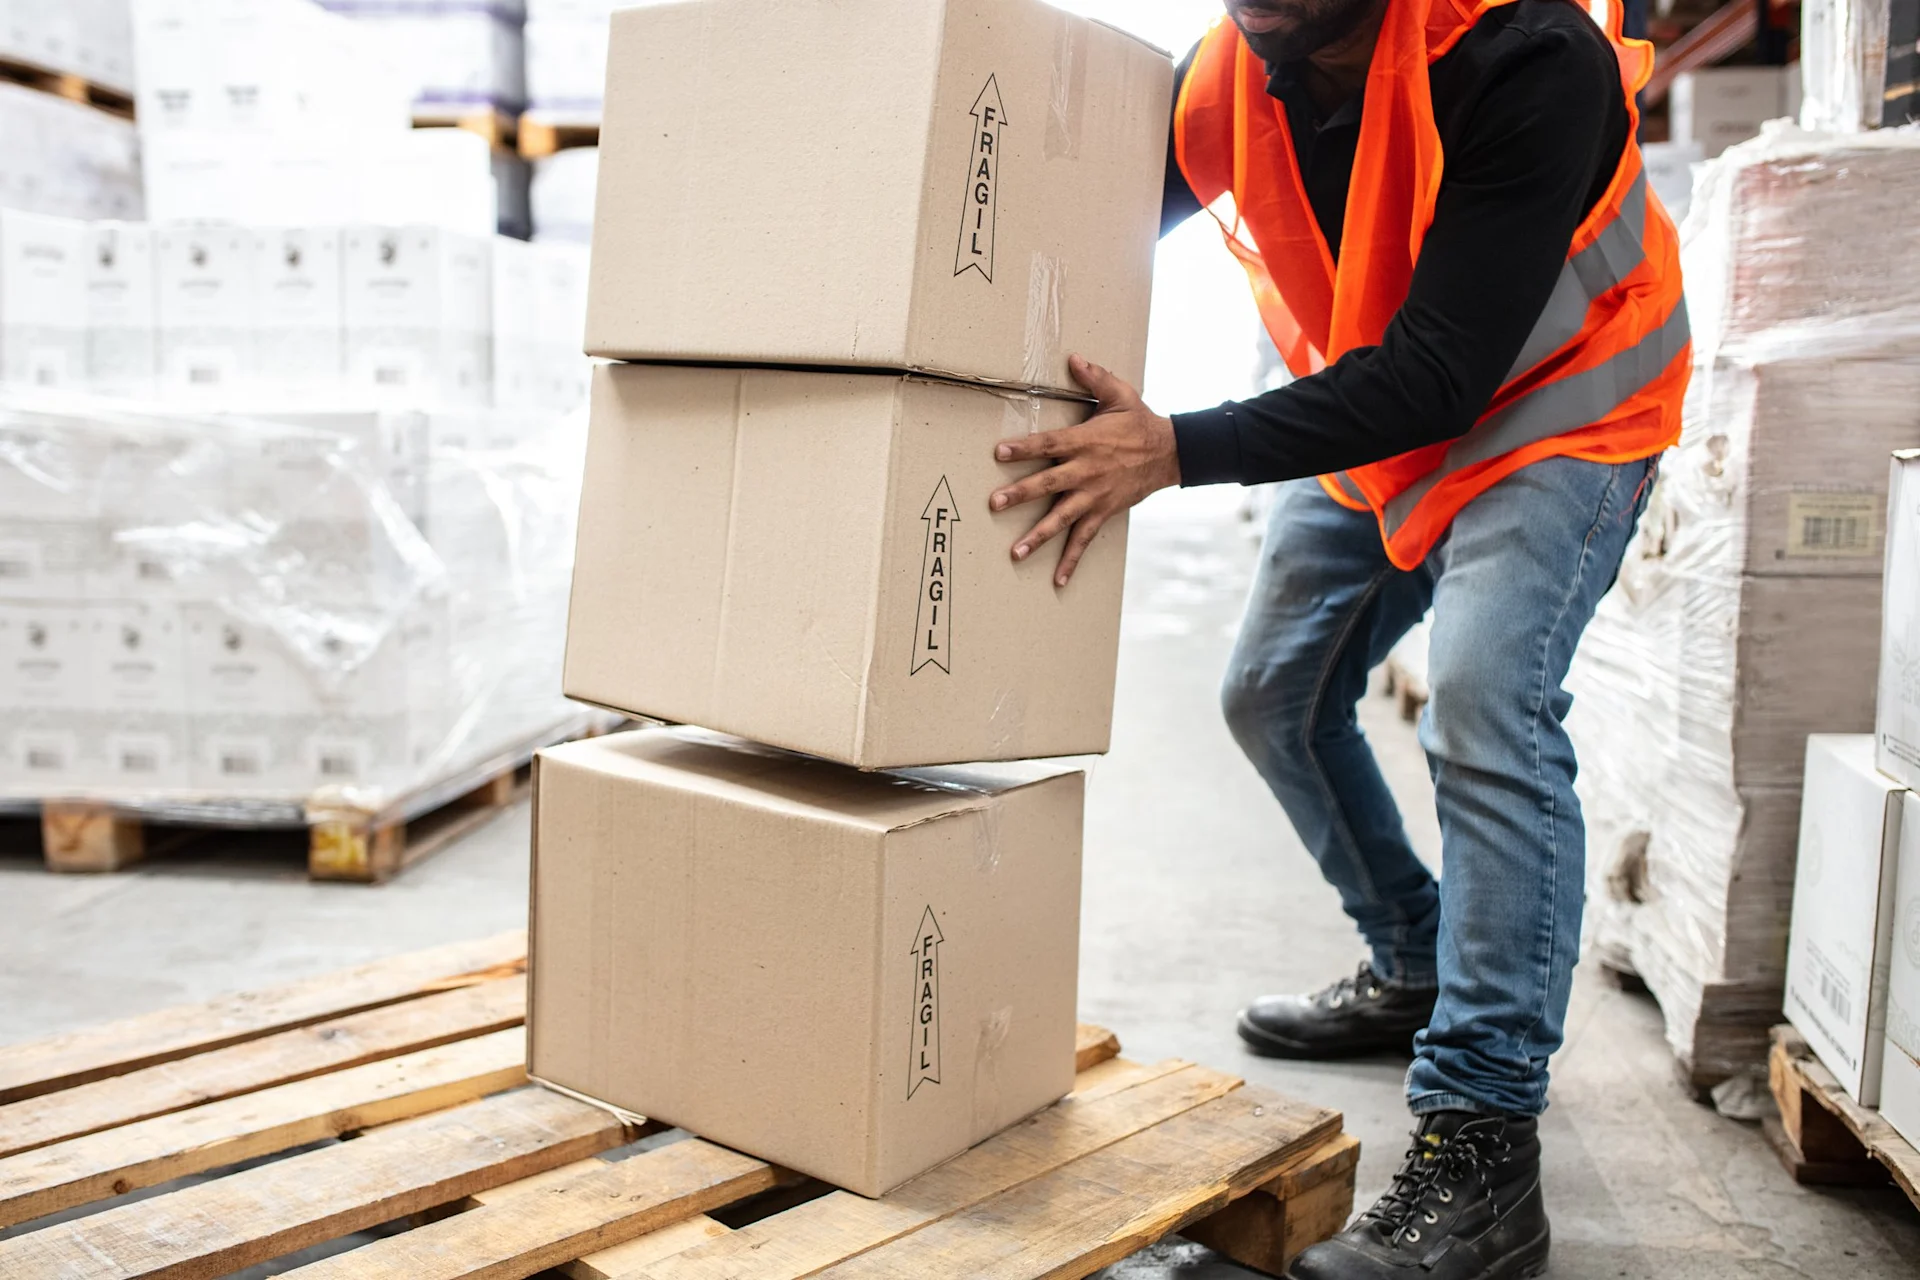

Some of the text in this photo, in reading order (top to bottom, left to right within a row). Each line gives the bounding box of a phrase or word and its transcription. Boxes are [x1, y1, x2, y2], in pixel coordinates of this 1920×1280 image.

[971, 106, 996, 255] FRAGIL
[927, 508, 948, 650] FRAGIL
[920, 934, 933, 1070] FRAGIL
